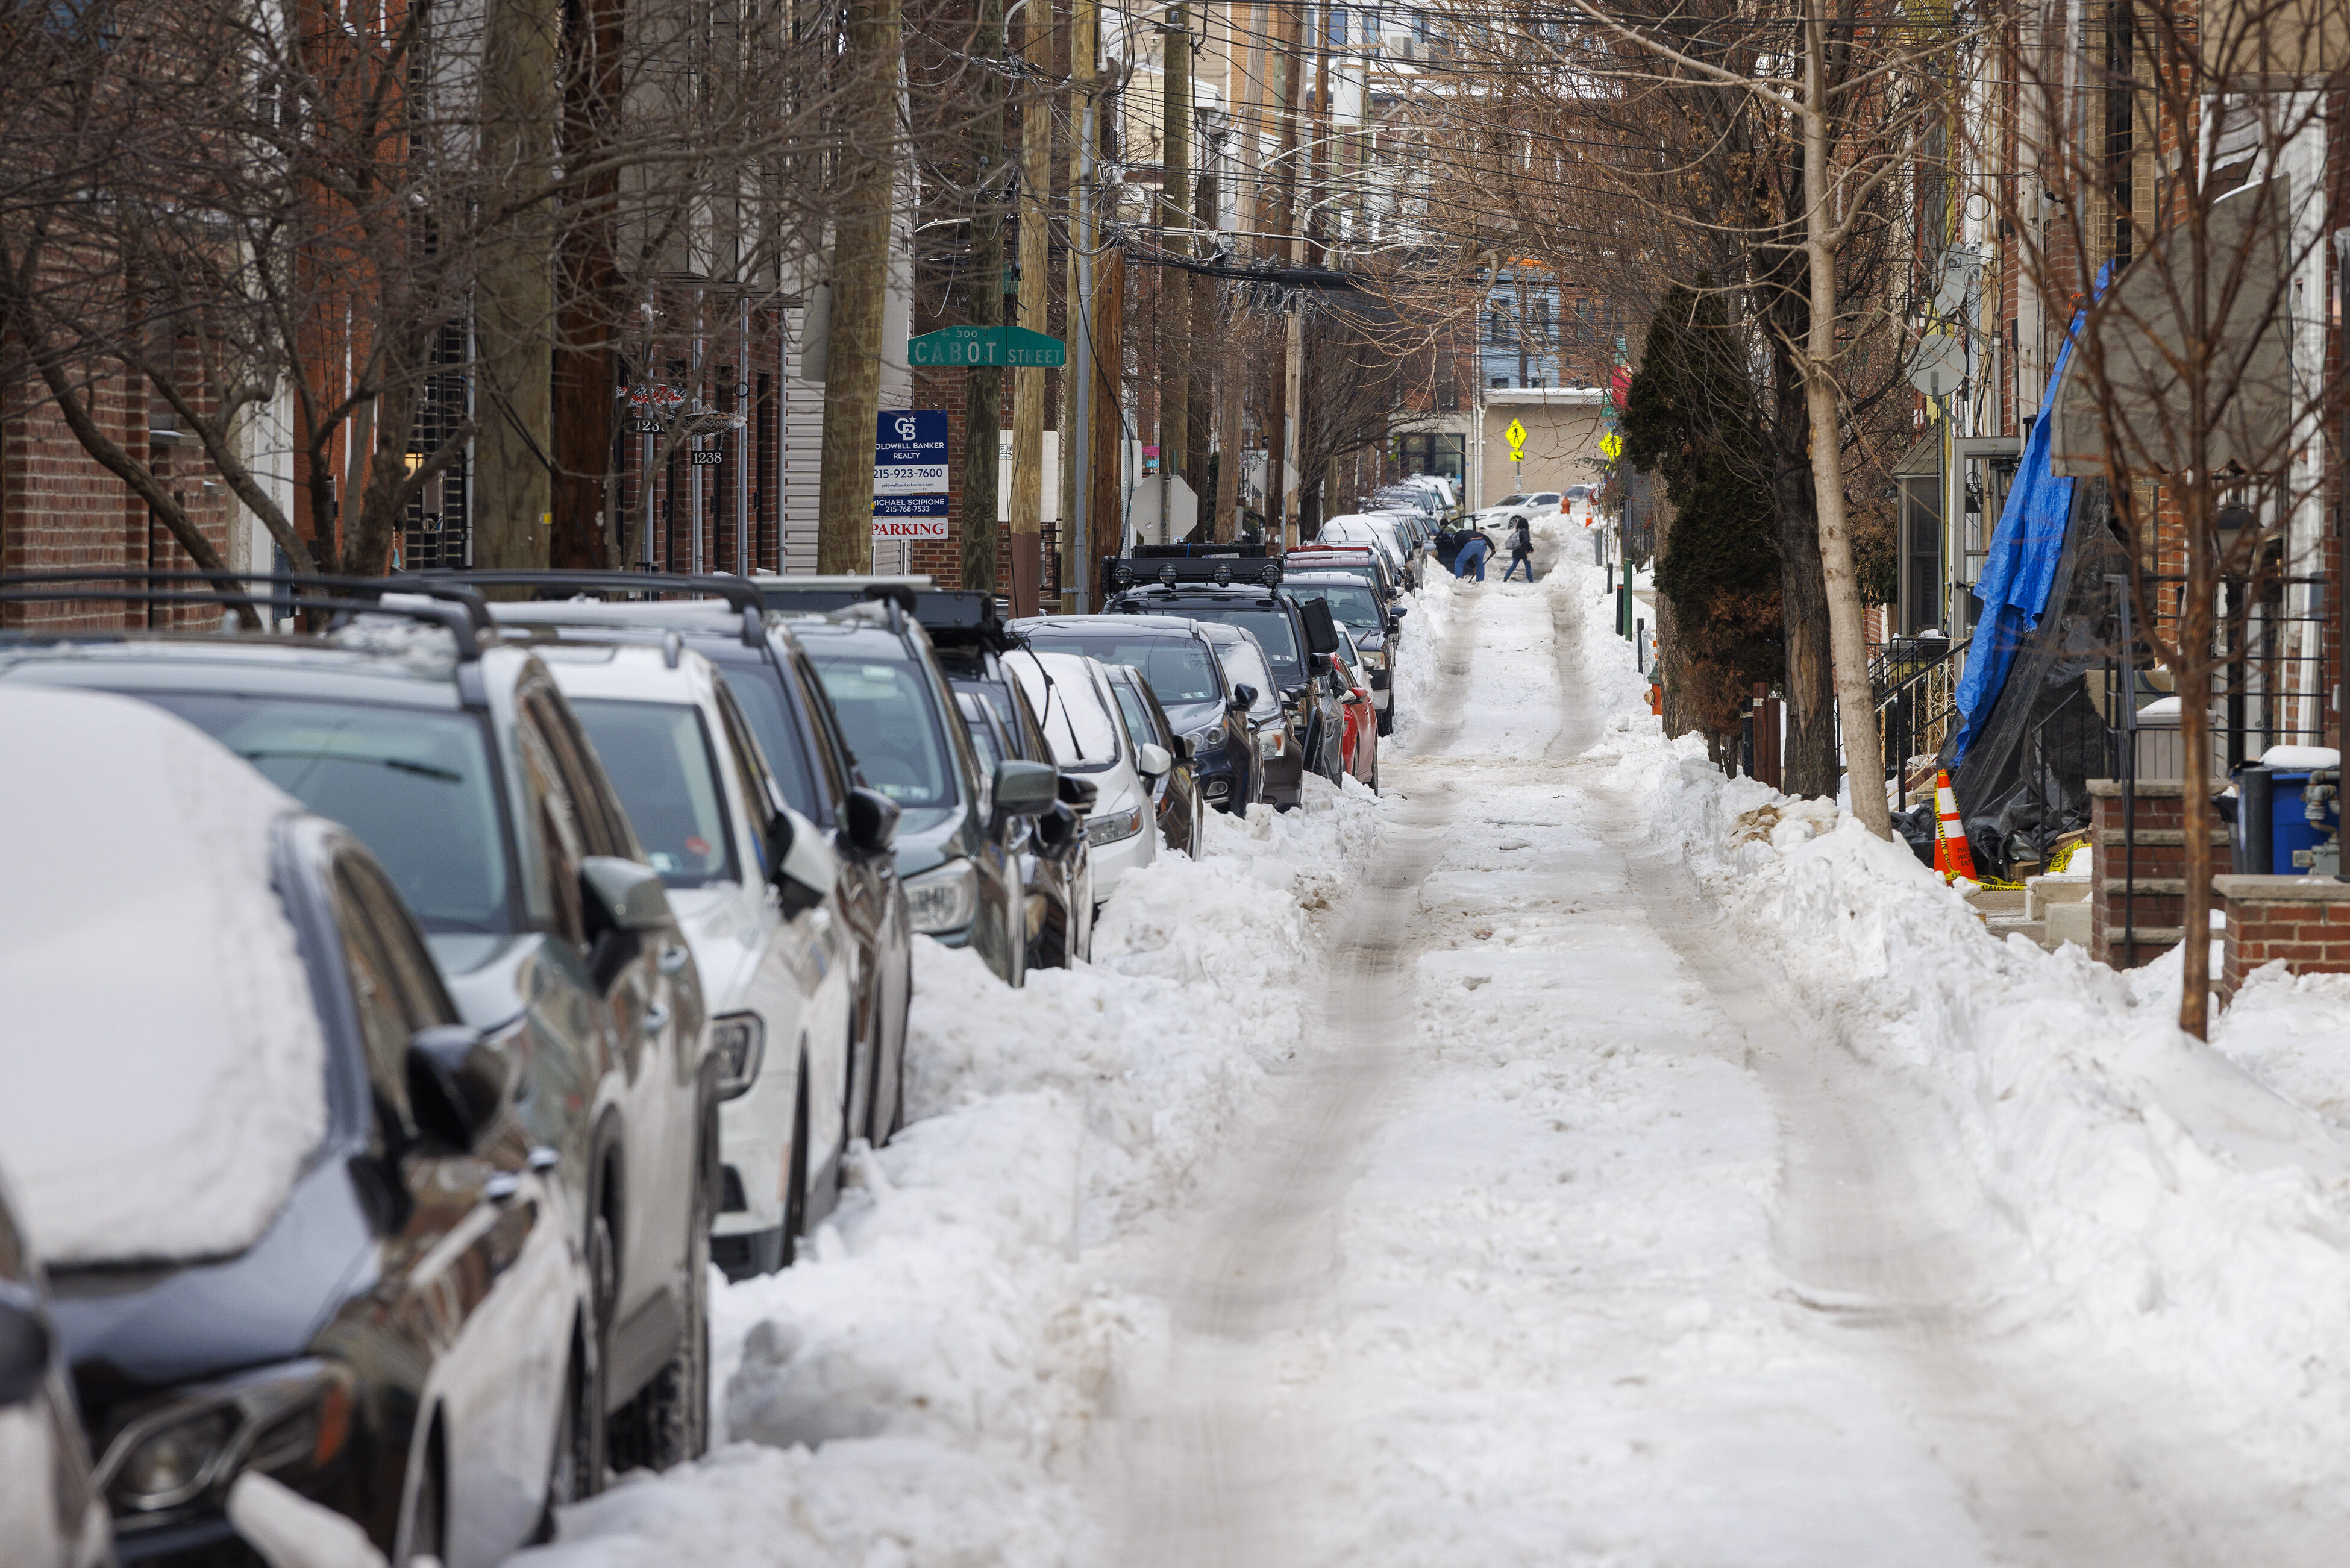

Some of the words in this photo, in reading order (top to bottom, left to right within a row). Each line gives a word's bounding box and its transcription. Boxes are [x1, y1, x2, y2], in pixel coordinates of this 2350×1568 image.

[915, 342, 996, 363] CABOT
[1007, 349, 1061, 363] STREET
[636, 420, 665, 431] 123
[895, 417, 916, 441] CB
[694, 452, 722, 463] 1238
[874, 468, 942, 478] 215-923-7600
[872, 523, 944, 535] PARKING
